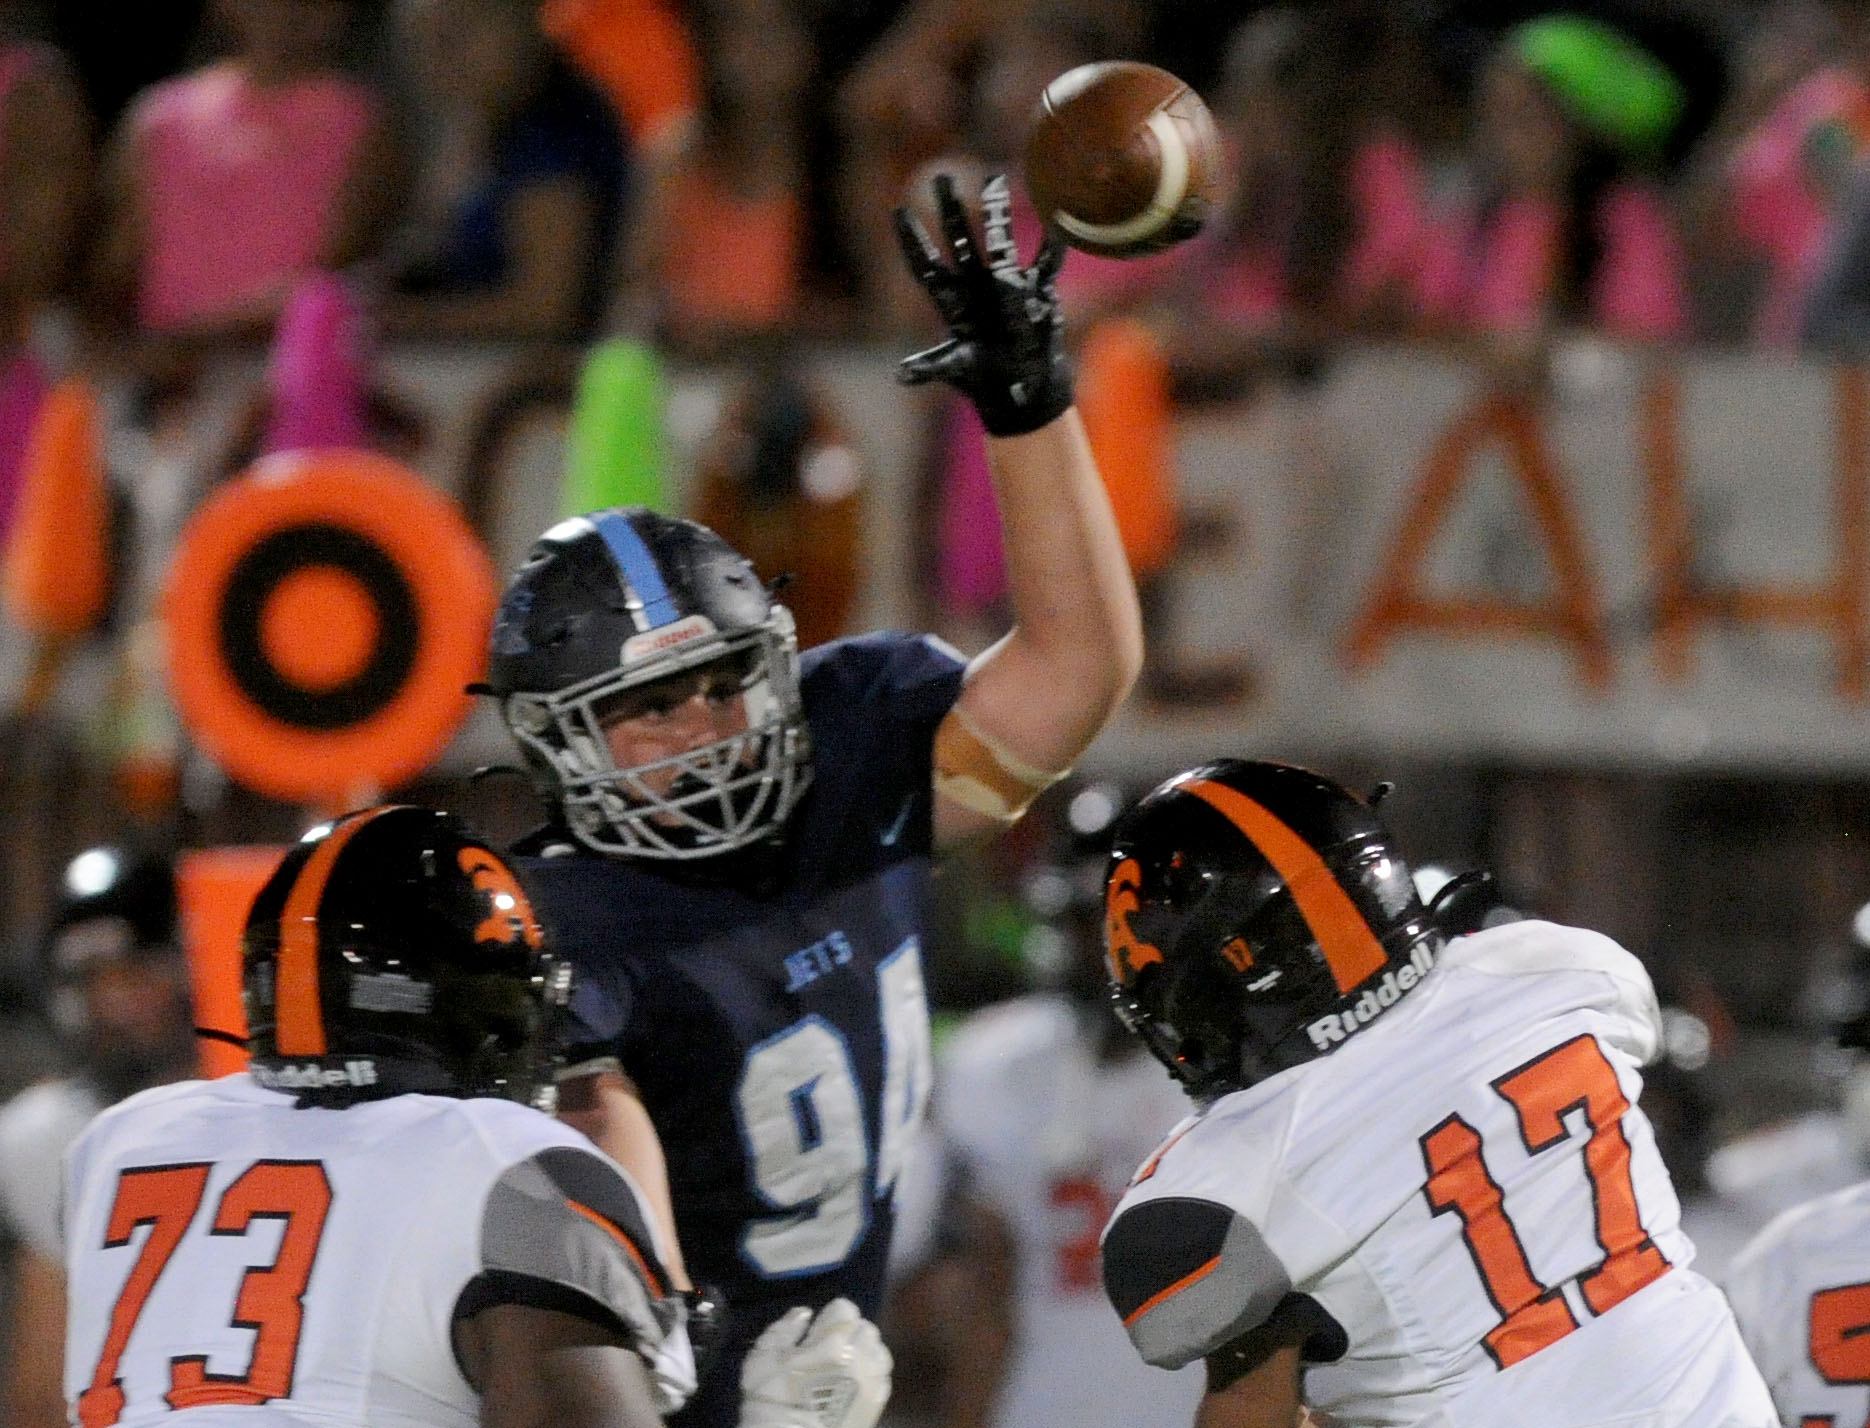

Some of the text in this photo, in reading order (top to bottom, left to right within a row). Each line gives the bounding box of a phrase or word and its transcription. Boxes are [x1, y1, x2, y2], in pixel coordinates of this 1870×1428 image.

[981, 173, 1035, 288] ALPHA
[784, 930, 853, 993] JETS
[1306, 941, 1435, 1050] Riddell
[1419, 1032, 1673, 1372] 17
[78, 1158, 334, 1428] 73
